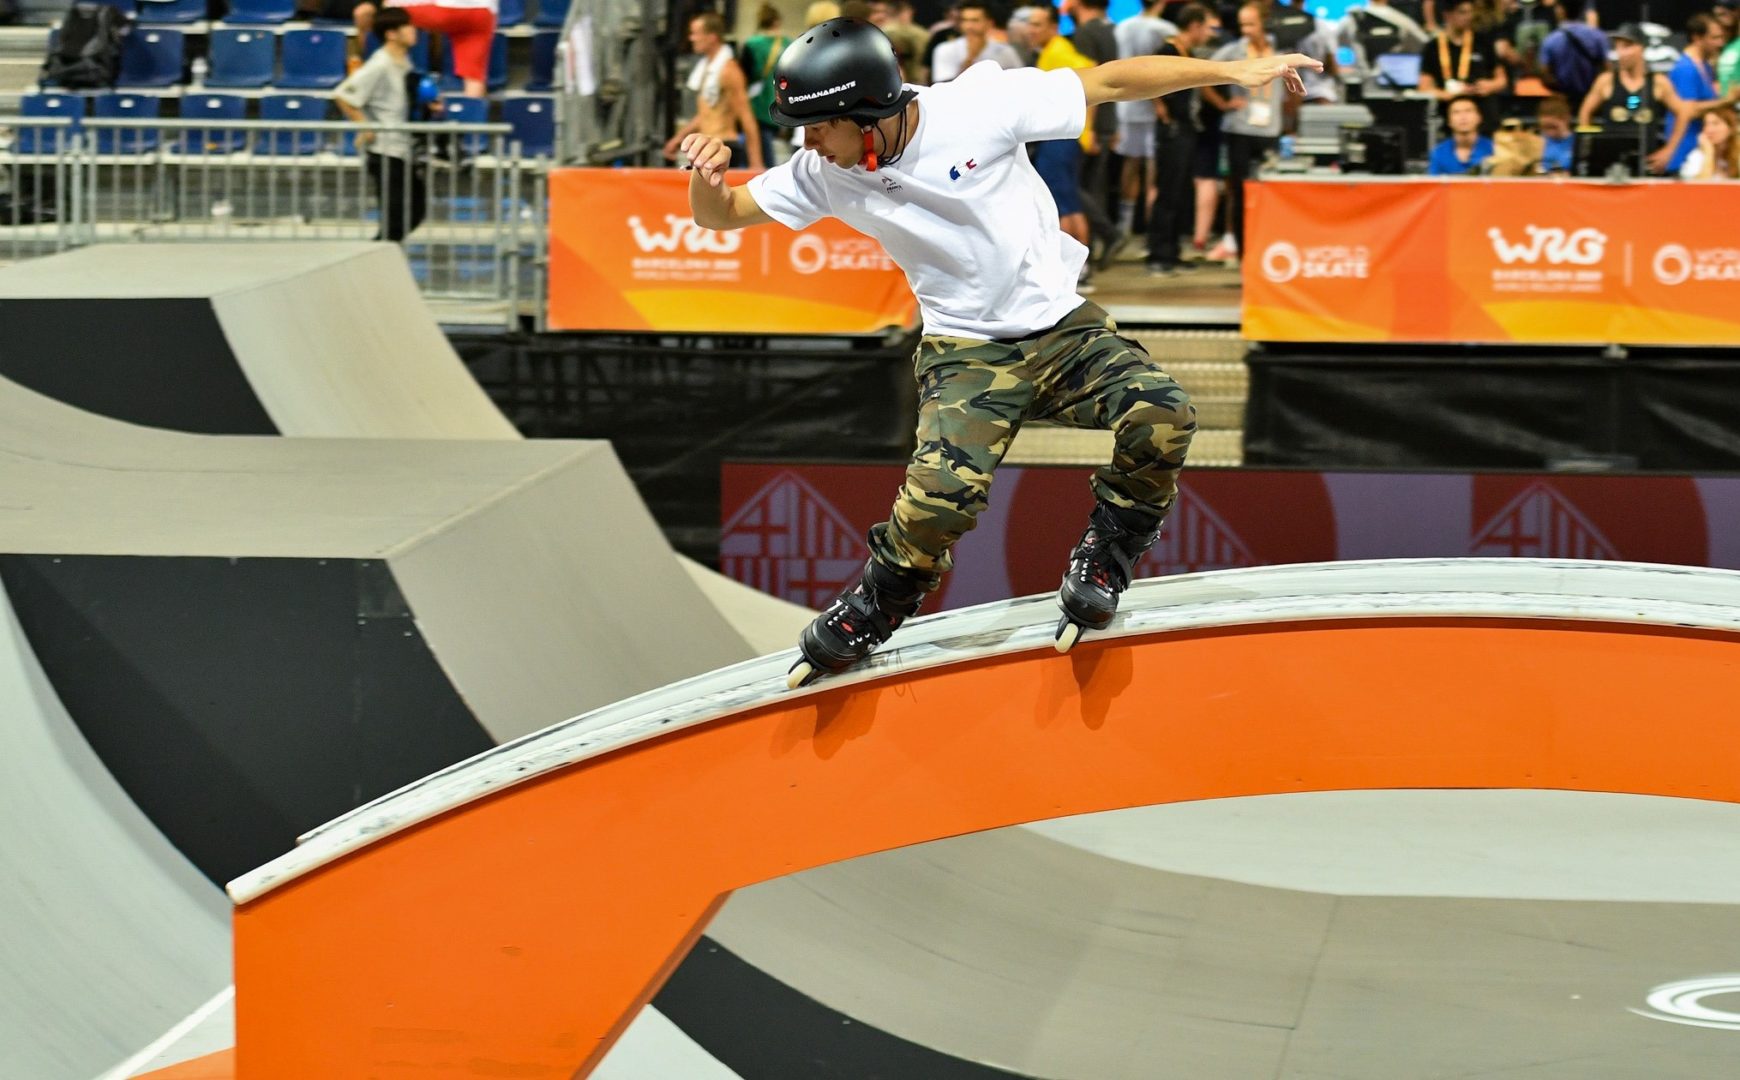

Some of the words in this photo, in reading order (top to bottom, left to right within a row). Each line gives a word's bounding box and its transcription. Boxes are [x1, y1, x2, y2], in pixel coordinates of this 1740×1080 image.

[1303, 246, 1368, 260] WORLD
[1487, 224, 1607, 265] WRG
[1302, 261, 1368, 278] SKATE
